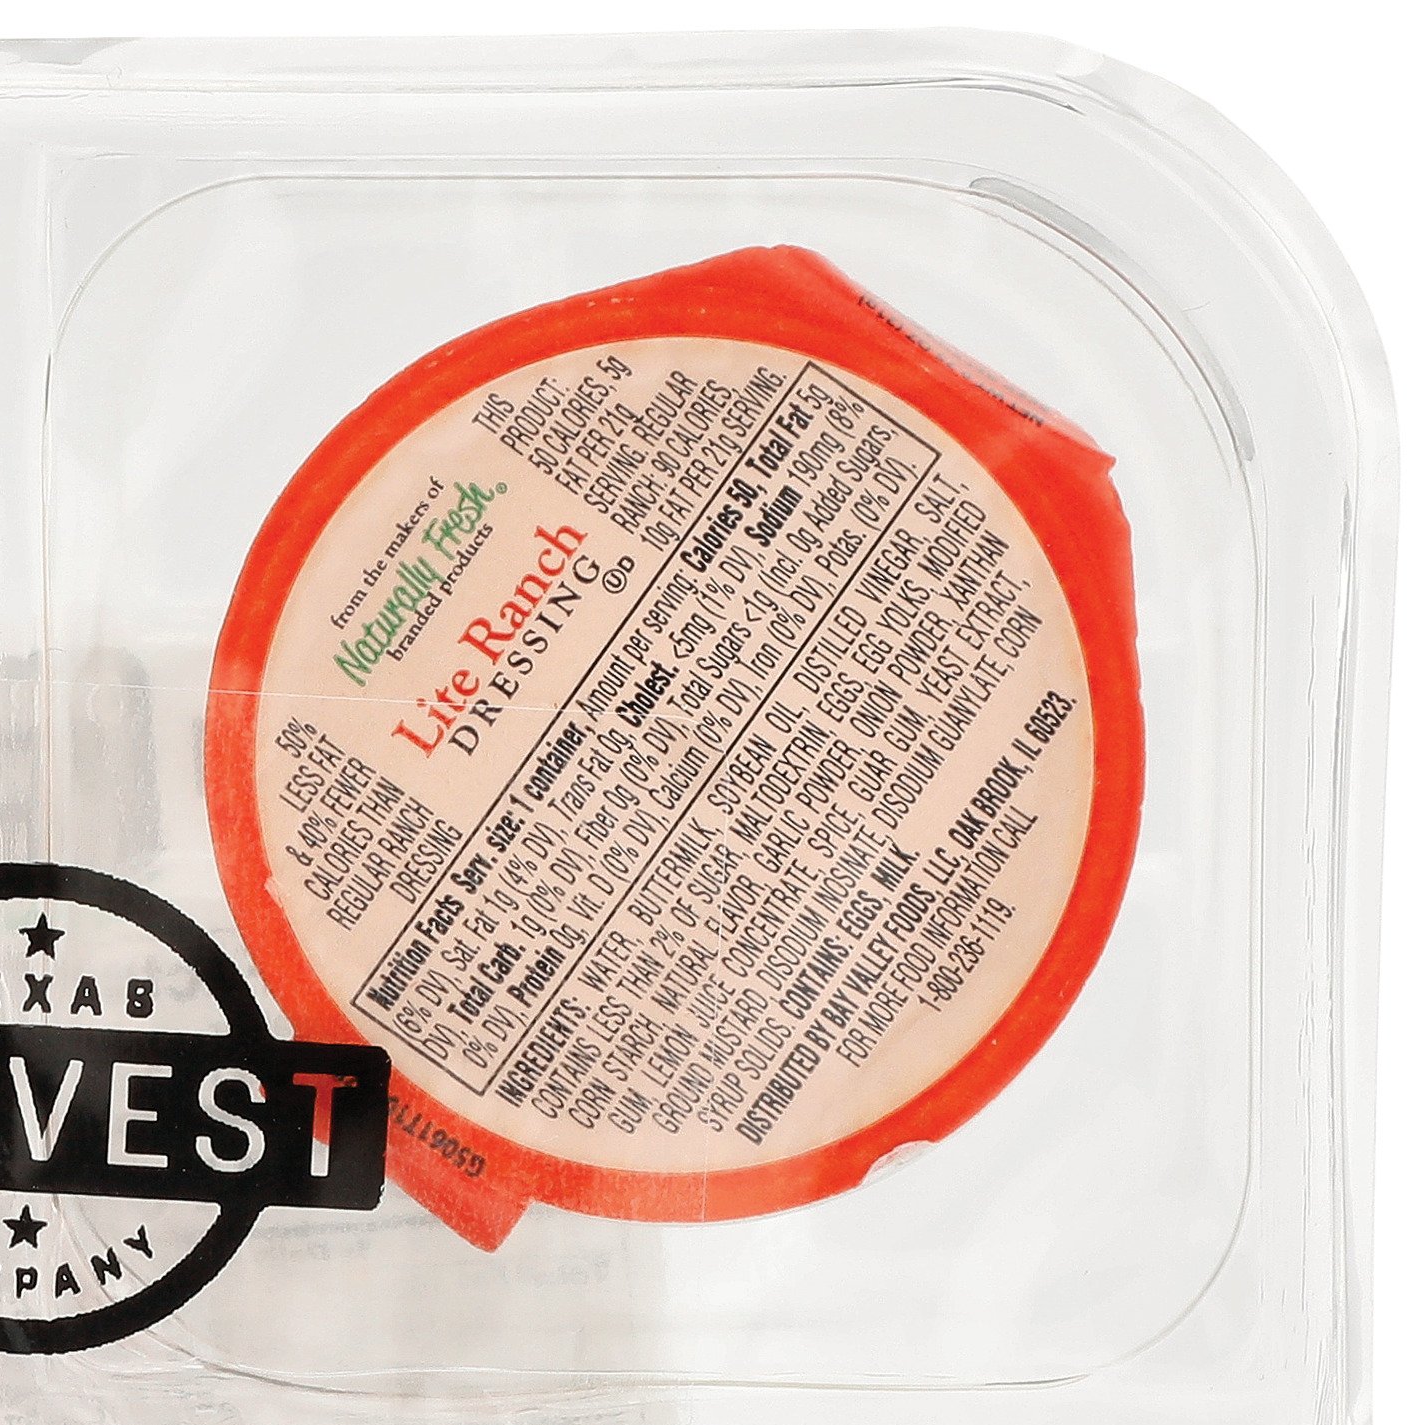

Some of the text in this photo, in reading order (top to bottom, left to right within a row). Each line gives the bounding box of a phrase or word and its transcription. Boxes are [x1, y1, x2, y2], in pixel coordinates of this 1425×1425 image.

[471, 390, 516, 437] THIS
[499, 372, 570, 456] PRODUCT:
[541, 369, 618, 459] CALORIES,
[554, 397, 640, 496] FAT PER 21g
[582, 367, 699, 515] SERVING. REGULAR
[609, 372, 740, 535] RANCH: 90 CALORIES,
[637, 360, 787, 558] 10g SERVING.
[325, 547, 446, 689] Naturally
[327, 474, 446, 630] from the makers of
[385, 518, 497, 662] branded products
[365, 399, 814, 1012] Nutrition Facts Serv. size: container, Amount per serving: Calories 50, Total Fat
[389, 506, 589, 762] Lite Ranch
[439, 425, 846, 973] Sat. Fat Trans Cholest. Sodium 190mg
[446, 549, 605, 756] DRESSING
[273, 712, 319, 760] 50%
[278, 733, 348, 815] LESS FAT
[447, 414, 901, 1027] Total Carb. Fiber Total Sugars Added Sugars,
[495, 990, 592, 1110] INGREDIENTS:
[577, 921, 645, 997] WATER,
[625, 811, 724, 930] BUTTERMILK,
[704, 731, 777, 816] SOYBEAN
[762, 690, 811, 738] OIL,
[791, 602, 870, 695] DISTILLED
[854, 520, 932, 610] VINEGAR,
[912, 467, 969, 528] SALT,
[505, 518, 867, 1008] Protein Calcium Iron Potas.
[283, 754, 377, 868] & 40% FEWER
[301, 774, 405, 903] CALORIES THAN
[326, 795, 435, 932] REGULAR RANCH
[388, 816, 464, 905] DRESSING
[530, 496, 989, 1122] CONTAINS LESS THAN SUGAR, MALTODEXTRIN, EGGS, EGG YOLKS, MODIFIED
[566, 527, 1010, 1132] CORN STARCH, NATURAL FLAVOR, GARLIC POWDER, ONION XANTHAN
[607, 564, 1032, 1139] GUM, LEMON CONCENTRATE, SPICE, GUAR YEAST EXTRACT,
[651, 603, 1043, 1136] GROUND MUSTARD, DISODIUM INOSINATE, DISODIUM GUANYLATE, CORN
[695, 836, 921, 1135] SYRUP SOLIDS. CONTAINS: EGGS, MILK.
[734, 682, 1078, 1147] DISTRIBUTED BY BAY VALLEY FOODS, LLC, OAK BROOK, 60523.
[835, 799, 1039, 1069] FOR MORE FOOD INFORMATION CALL
[915, 890, 1017, 1017] 1-800-236-1119.
